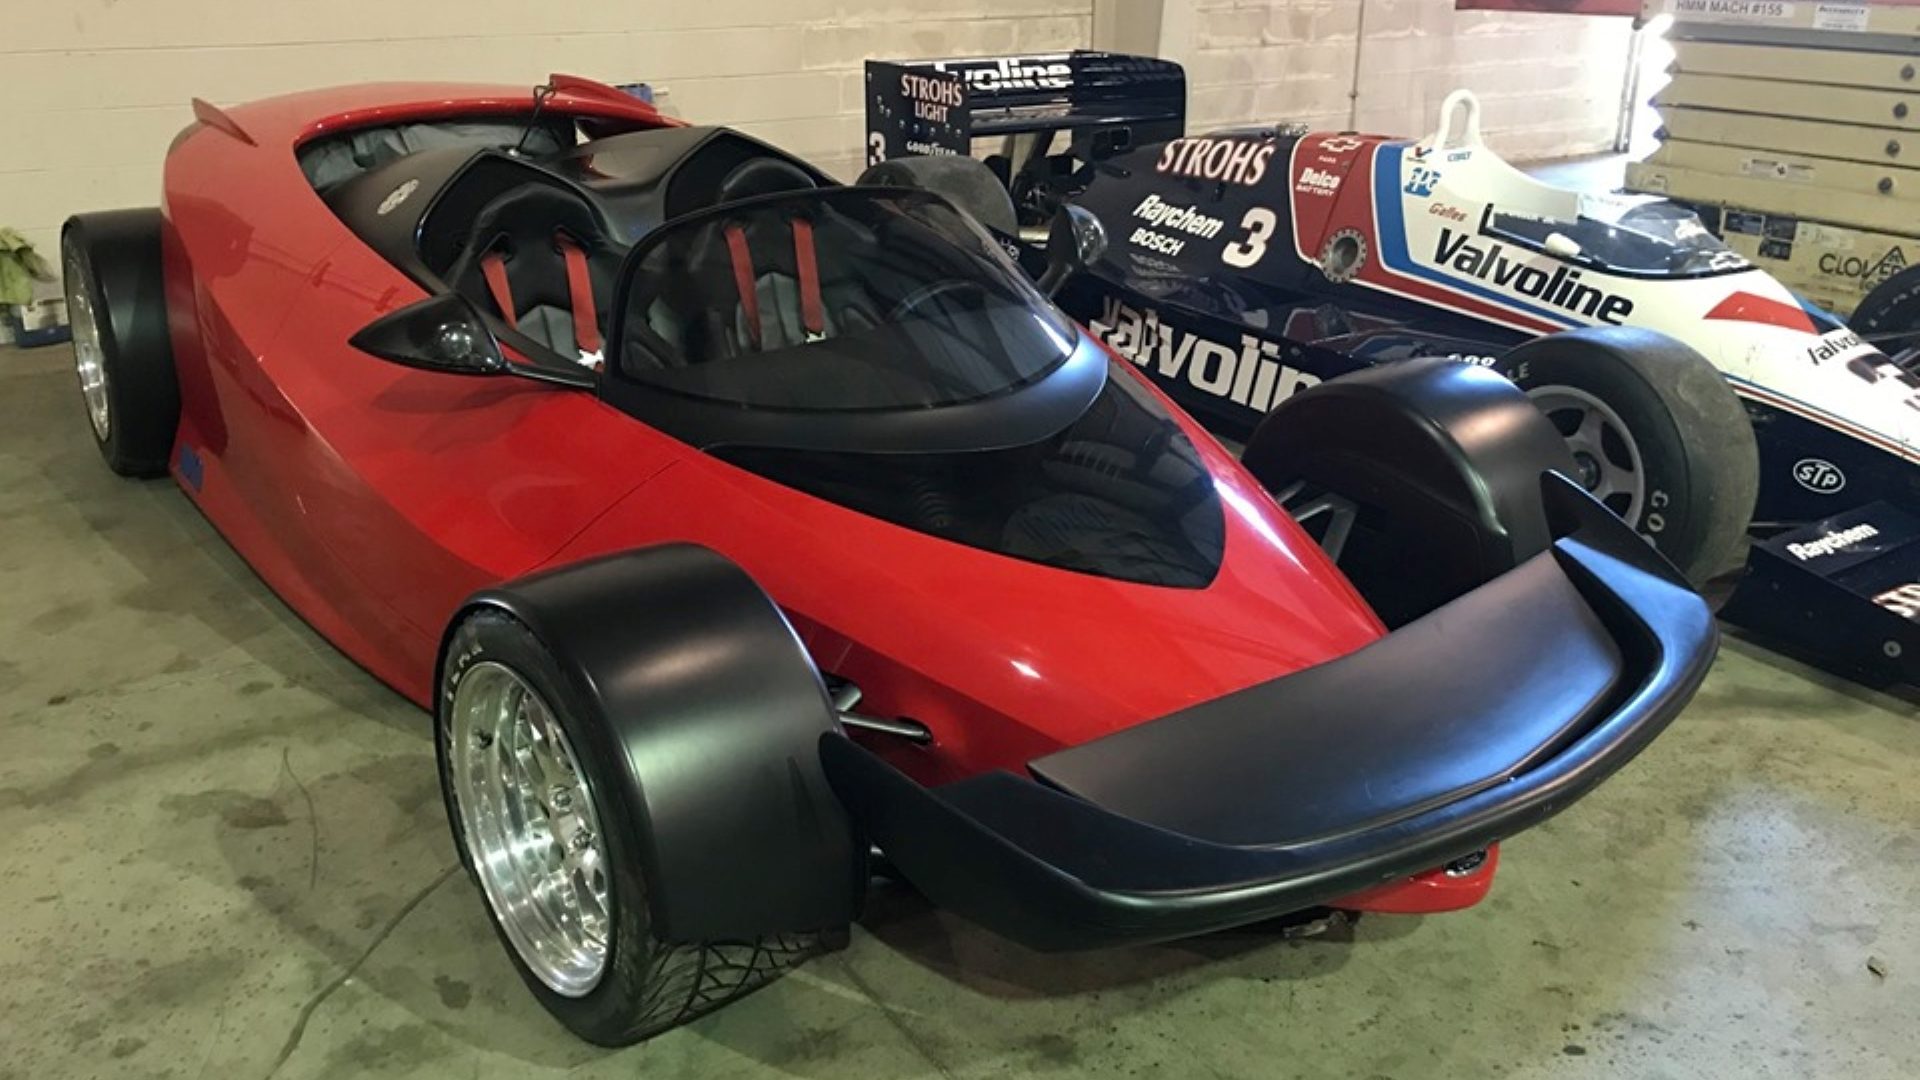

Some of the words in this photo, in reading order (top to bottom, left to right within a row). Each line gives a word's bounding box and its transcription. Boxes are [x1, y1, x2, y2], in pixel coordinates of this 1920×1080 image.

[1709, 1, 1750, 14] MACH
[1751, 4, 1784, 16] #155
[914, 101, 949, 122] LIGHT
[868, 131, 886, 166] 3
[1299, 167, 1341, 189] Delco
[1132, 194, 1224, 240] Raychem
[1428, 202, 1467, 222] Galles
[1129, 227, 1186, 257] BOSCH
[1221, 207, 1277, 268] 3
[1433, 228, 1634, 326] Valvoline
[1799, 463, 1839, 488] STP
[1787, 523, 1879, 561] Raychem
